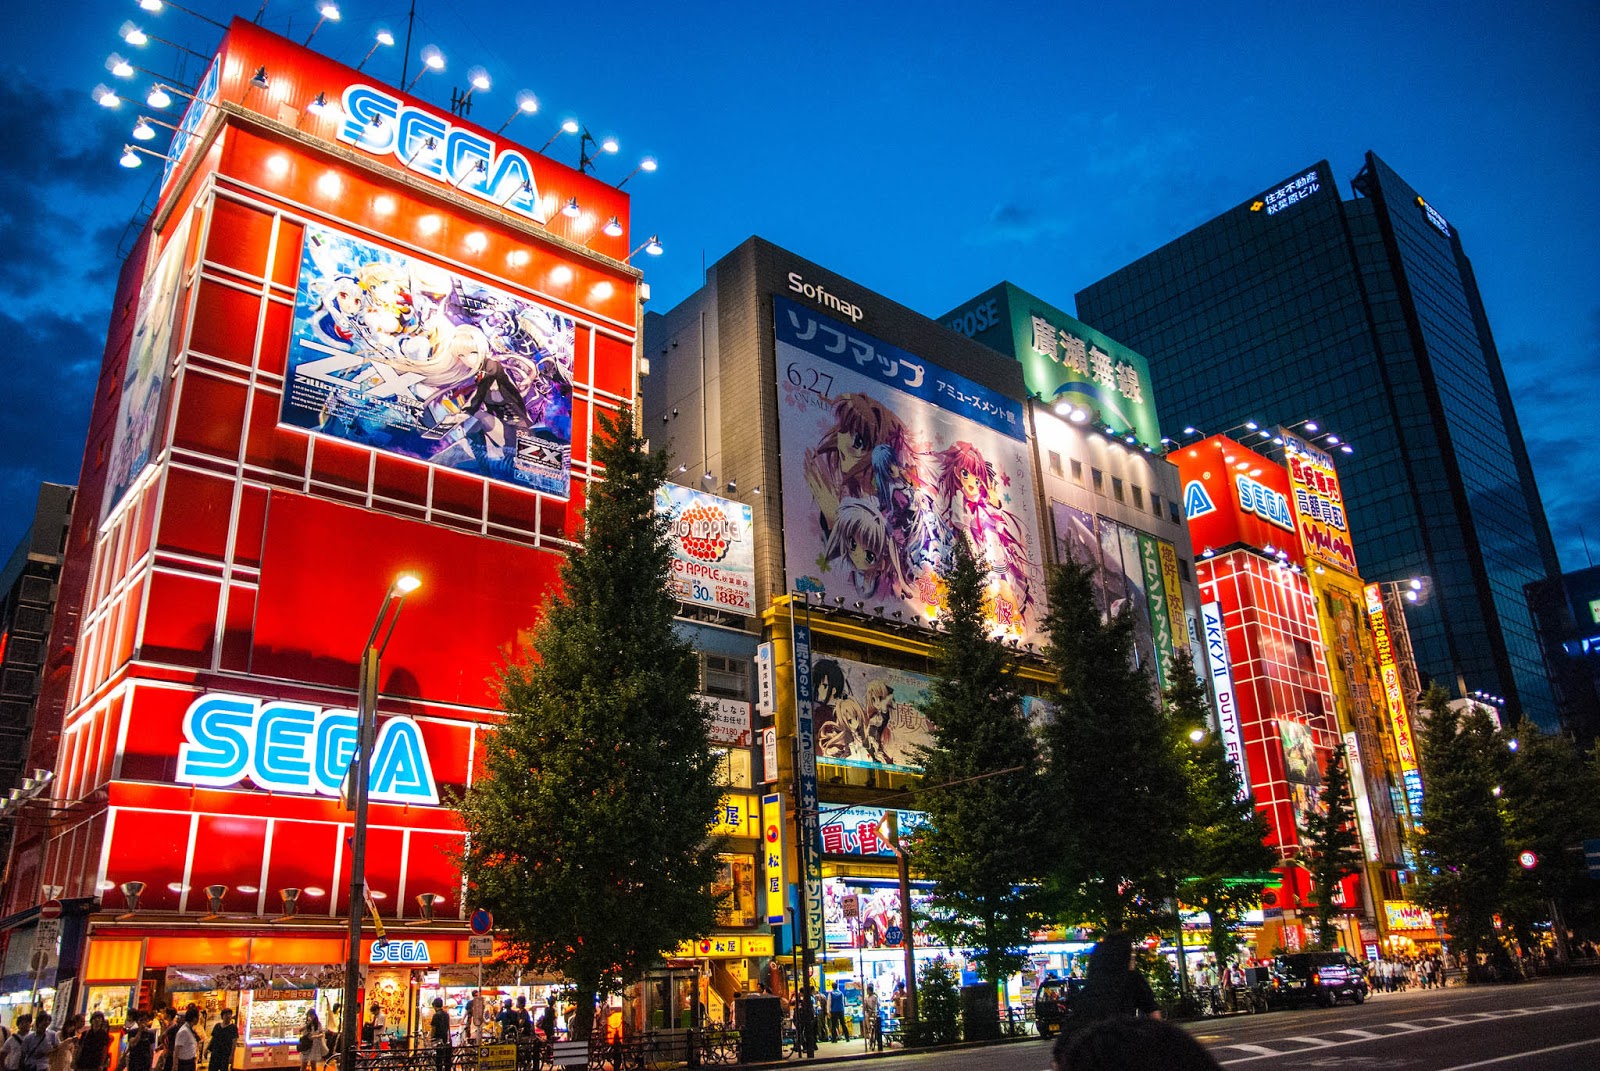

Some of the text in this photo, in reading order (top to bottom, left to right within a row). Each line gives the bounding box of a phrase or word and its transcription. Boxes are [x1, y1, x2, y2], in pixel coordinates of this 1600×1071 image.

[336, 84, 545, 224] SEGA
[1265, 171, 1317, 204] 住友不動産
[1267, 182, 1320, 216] 秋葉原ビル
[788, 271, 864, 323] Sofmap
[786, 308, 926, 389] ソフマップ
[1031, 314, 1144, 405] 廣瀬無線
[786, 362, 834, 397] 6.27
[936, 379, 1017, 426] アミューズメント館
[1236, 474, 1296, 534] SEGA
[693, 521, 742, 542] APPLE
[1302, 522, 1356, 567] Mulan
[1218, 692, 1236, 734] DUTY
[174, 692, 441, 804] SEGA
[1346, 736, 1359, 764] GAME
[768, 853, 780, 893] 松屋
[1522, 854, 1534, 865] 50
[807, 883, 823, 951] ソフマップ
[886, 931, 901, 940] 437
[371, 940, 431, 963] SEGA
[715, 940, 736, 952] 松屋
